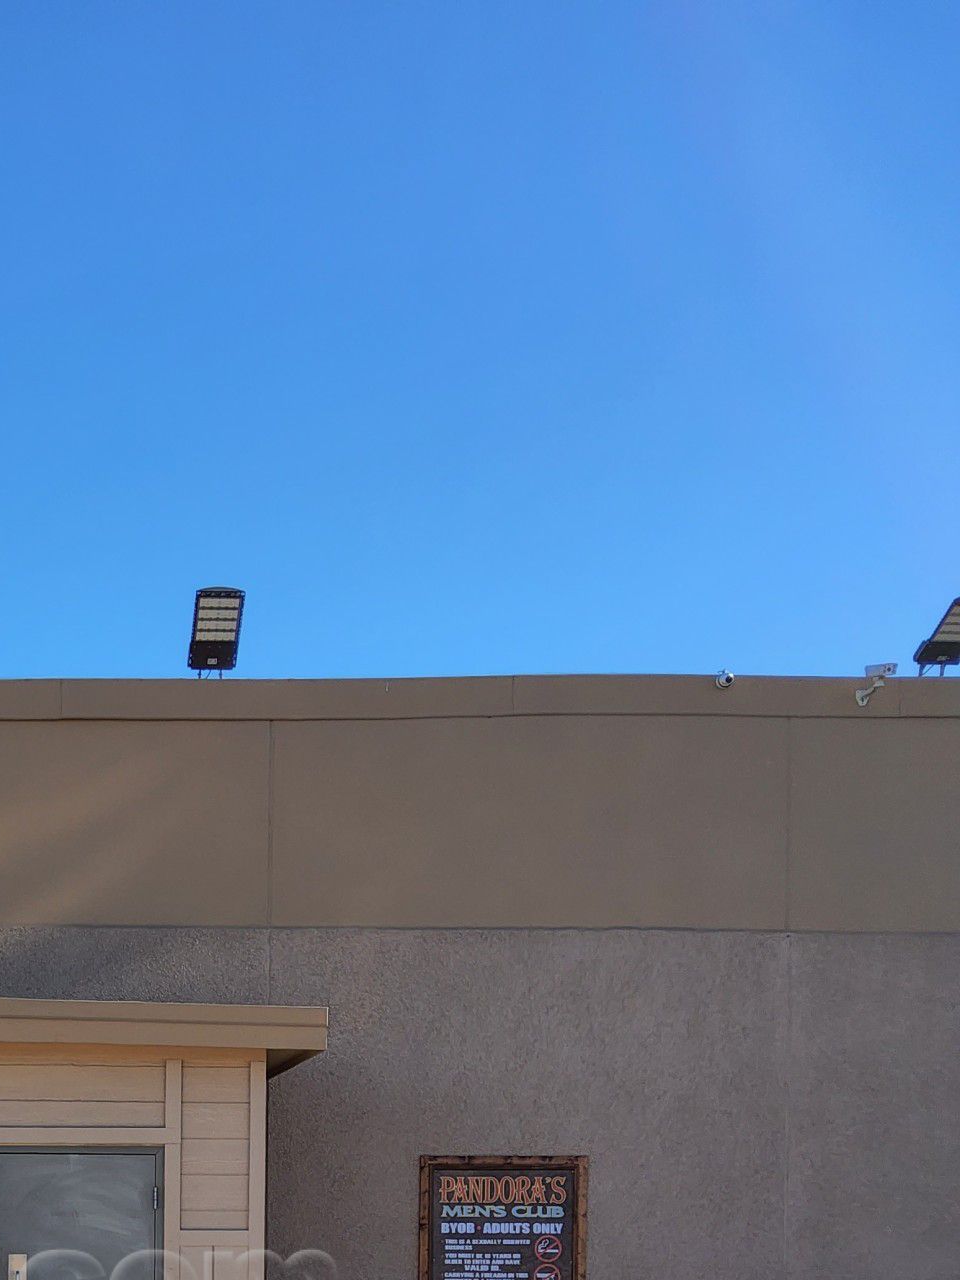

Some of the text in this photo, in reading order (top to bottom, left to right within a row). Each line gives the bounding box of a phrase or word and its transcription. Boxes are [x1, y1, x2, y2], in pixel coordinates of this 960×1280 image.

[439, 1176, 566, 1205] PANDORA'S
[512, 1205, 565, 1218] CLUB
[441, 1223, 563, 1234] BYOB ADULTS ONLY
